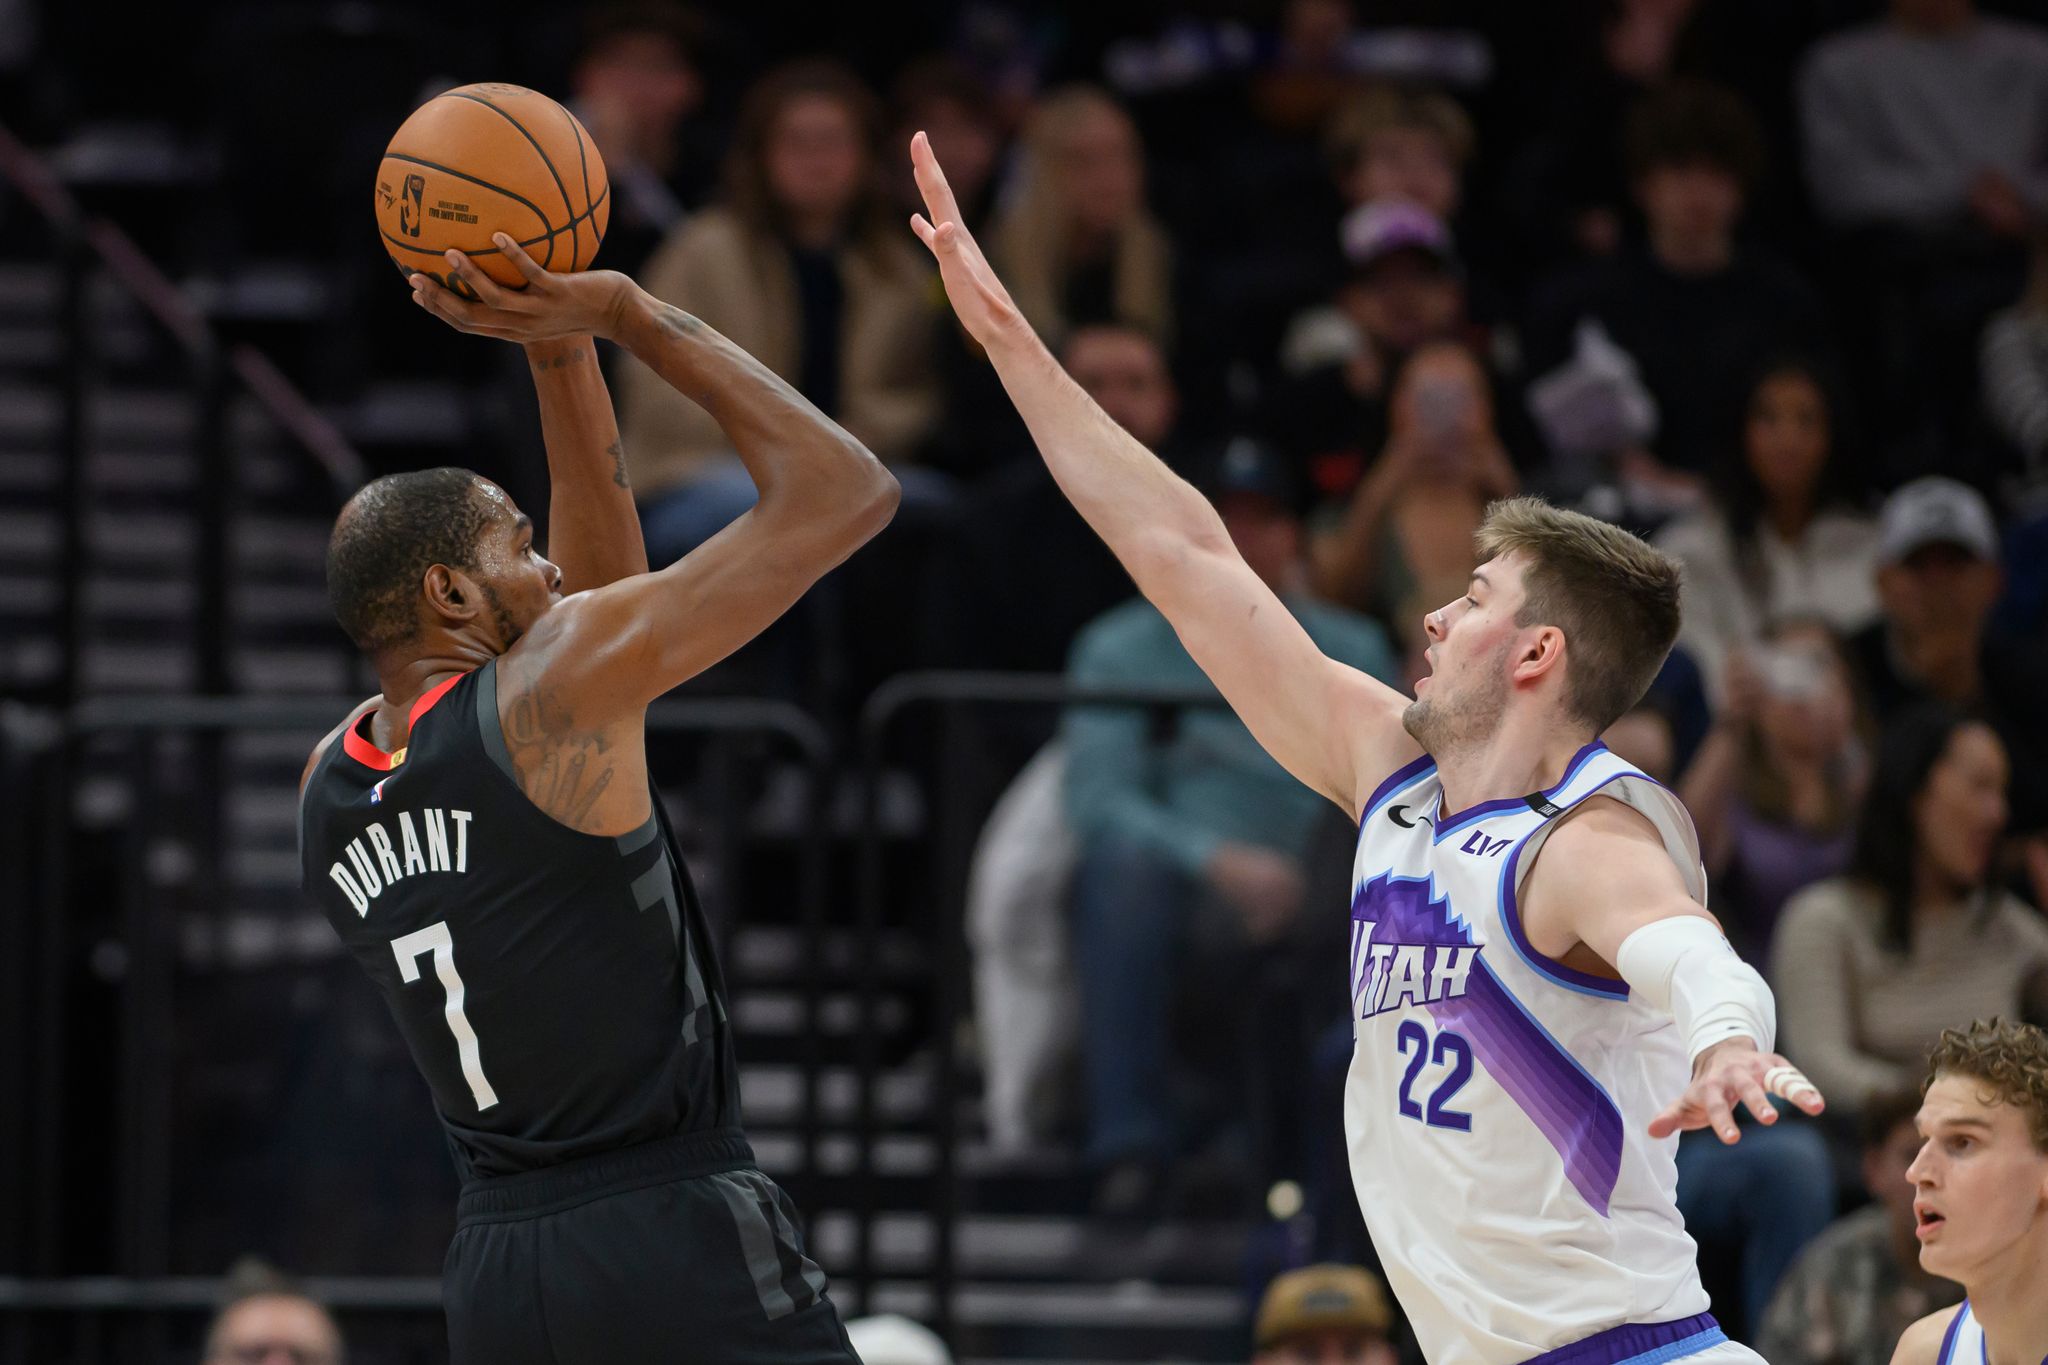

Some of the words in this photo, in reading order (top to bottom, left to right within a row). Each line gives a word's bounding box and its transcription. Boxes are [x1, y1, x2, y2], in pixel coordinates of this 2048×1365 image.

[329, 808, 472, 918] DURANT
[390, 921, 499, 1112] 7
[1397, 1019, 1474, 1132] 22
